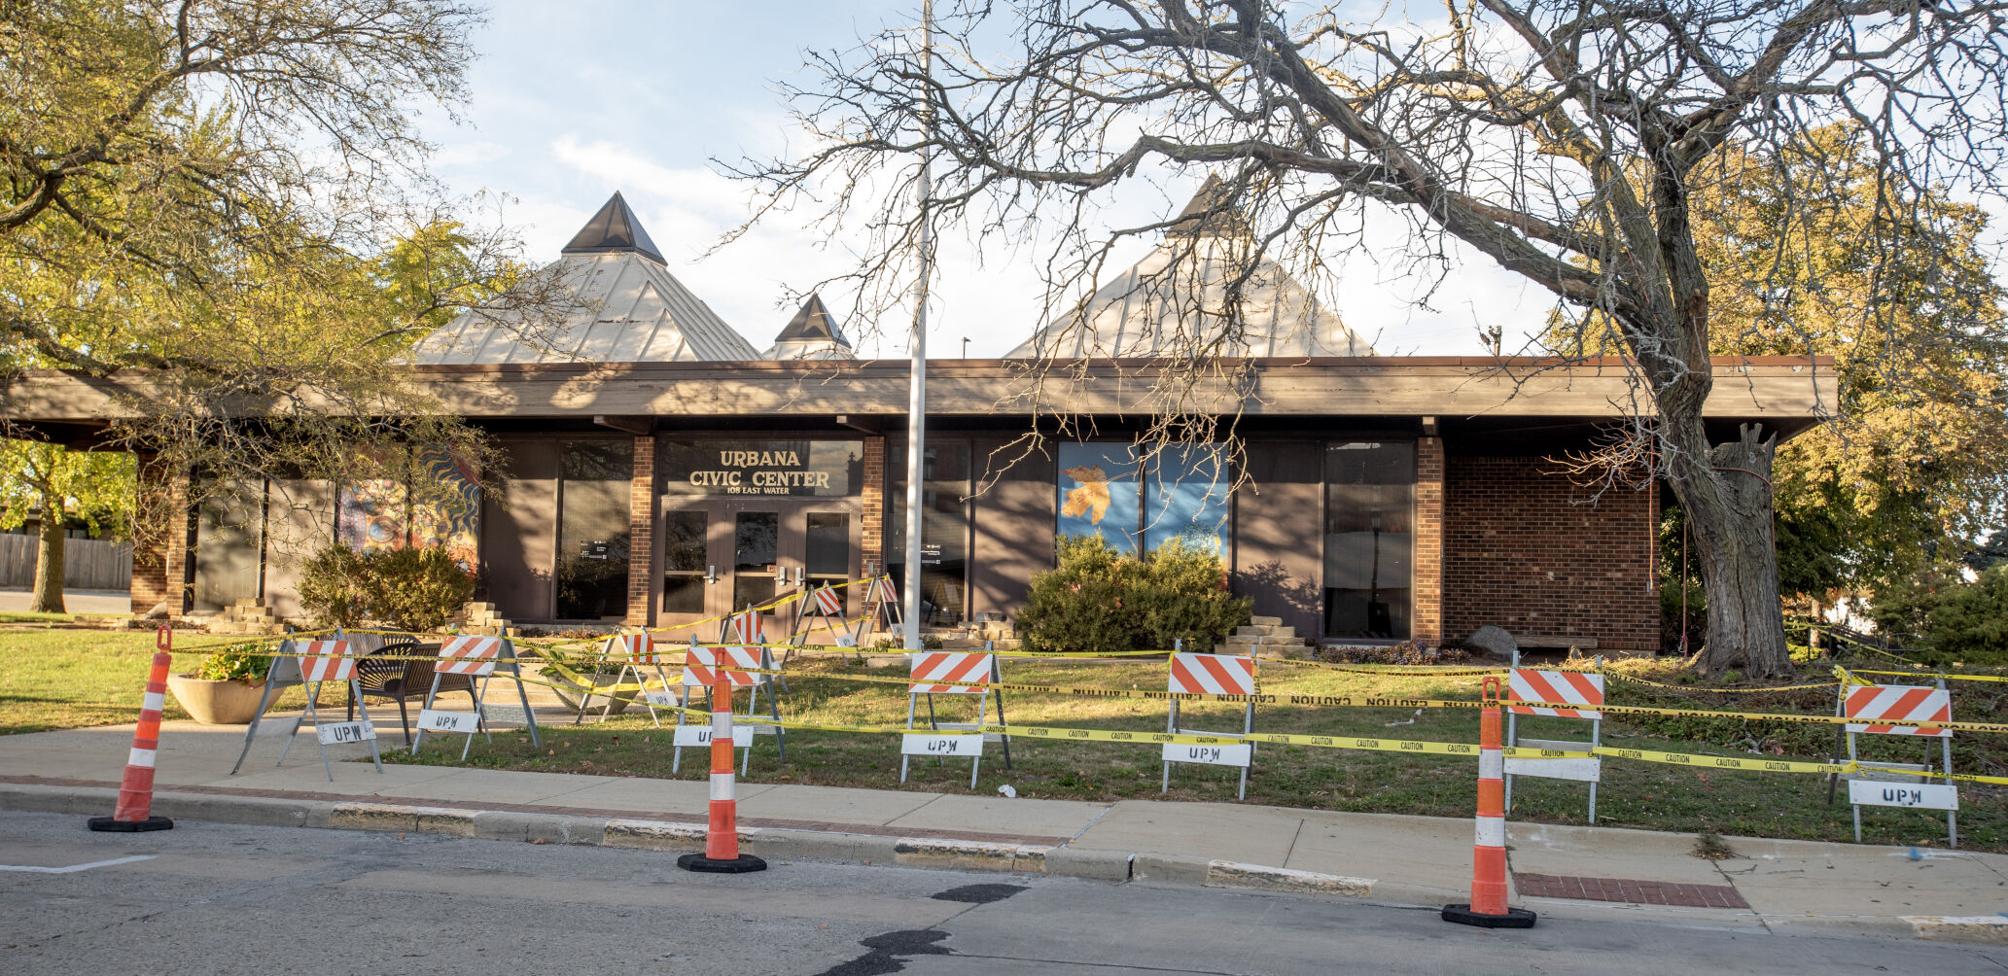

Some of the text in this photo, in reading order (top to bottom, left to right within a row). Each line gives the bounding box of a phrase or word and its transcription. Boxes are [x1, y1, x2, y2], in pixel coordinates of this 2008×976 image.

[720, 450, 801, 469] URBANA
[689, 470, 830, 489] CIVIC CENTER
[727, 486, 790, 495] 108 EAST WATER
[1216, 694, 1276, 704] CAUTION
[1290, 695, 1352, 706] CAUTION
[1366, 697, 1428, 707] CAUTION
[436, 716, 459, 729] UPW
[333, 725, 362, 742] UPW
[1027, 727, 1049, 737] CAUTION
[1068, 730, 1090, 738] CAUTION
[1110, 732, 1133, 740] CAUTION
[1152, 733, 1174, 742] CAUTION
[927, 740, 958, 753] UPW
[1267, 735, 1290, 744] CAUTION
[1311, 736, 1333, 745] CAUTION
[1356, 739, 1379, 748] CAUTION
[1400, 741, 1424, 750] CAUTION
[1447, 744, 1471, 753] CAUTION
[1540, 749, 1565, 757] CAUTION
[1188, 747, 1221, 761] UPW
[1618, 749, 1642, 759] CAUTION
[1665, 753, 1690, 764] CAUTION
[1715, 758, 1741, 768] CAUTION
[1765, 761, 1790, 771] CAUTION
[1882, 788, 1922, 804] UPW
